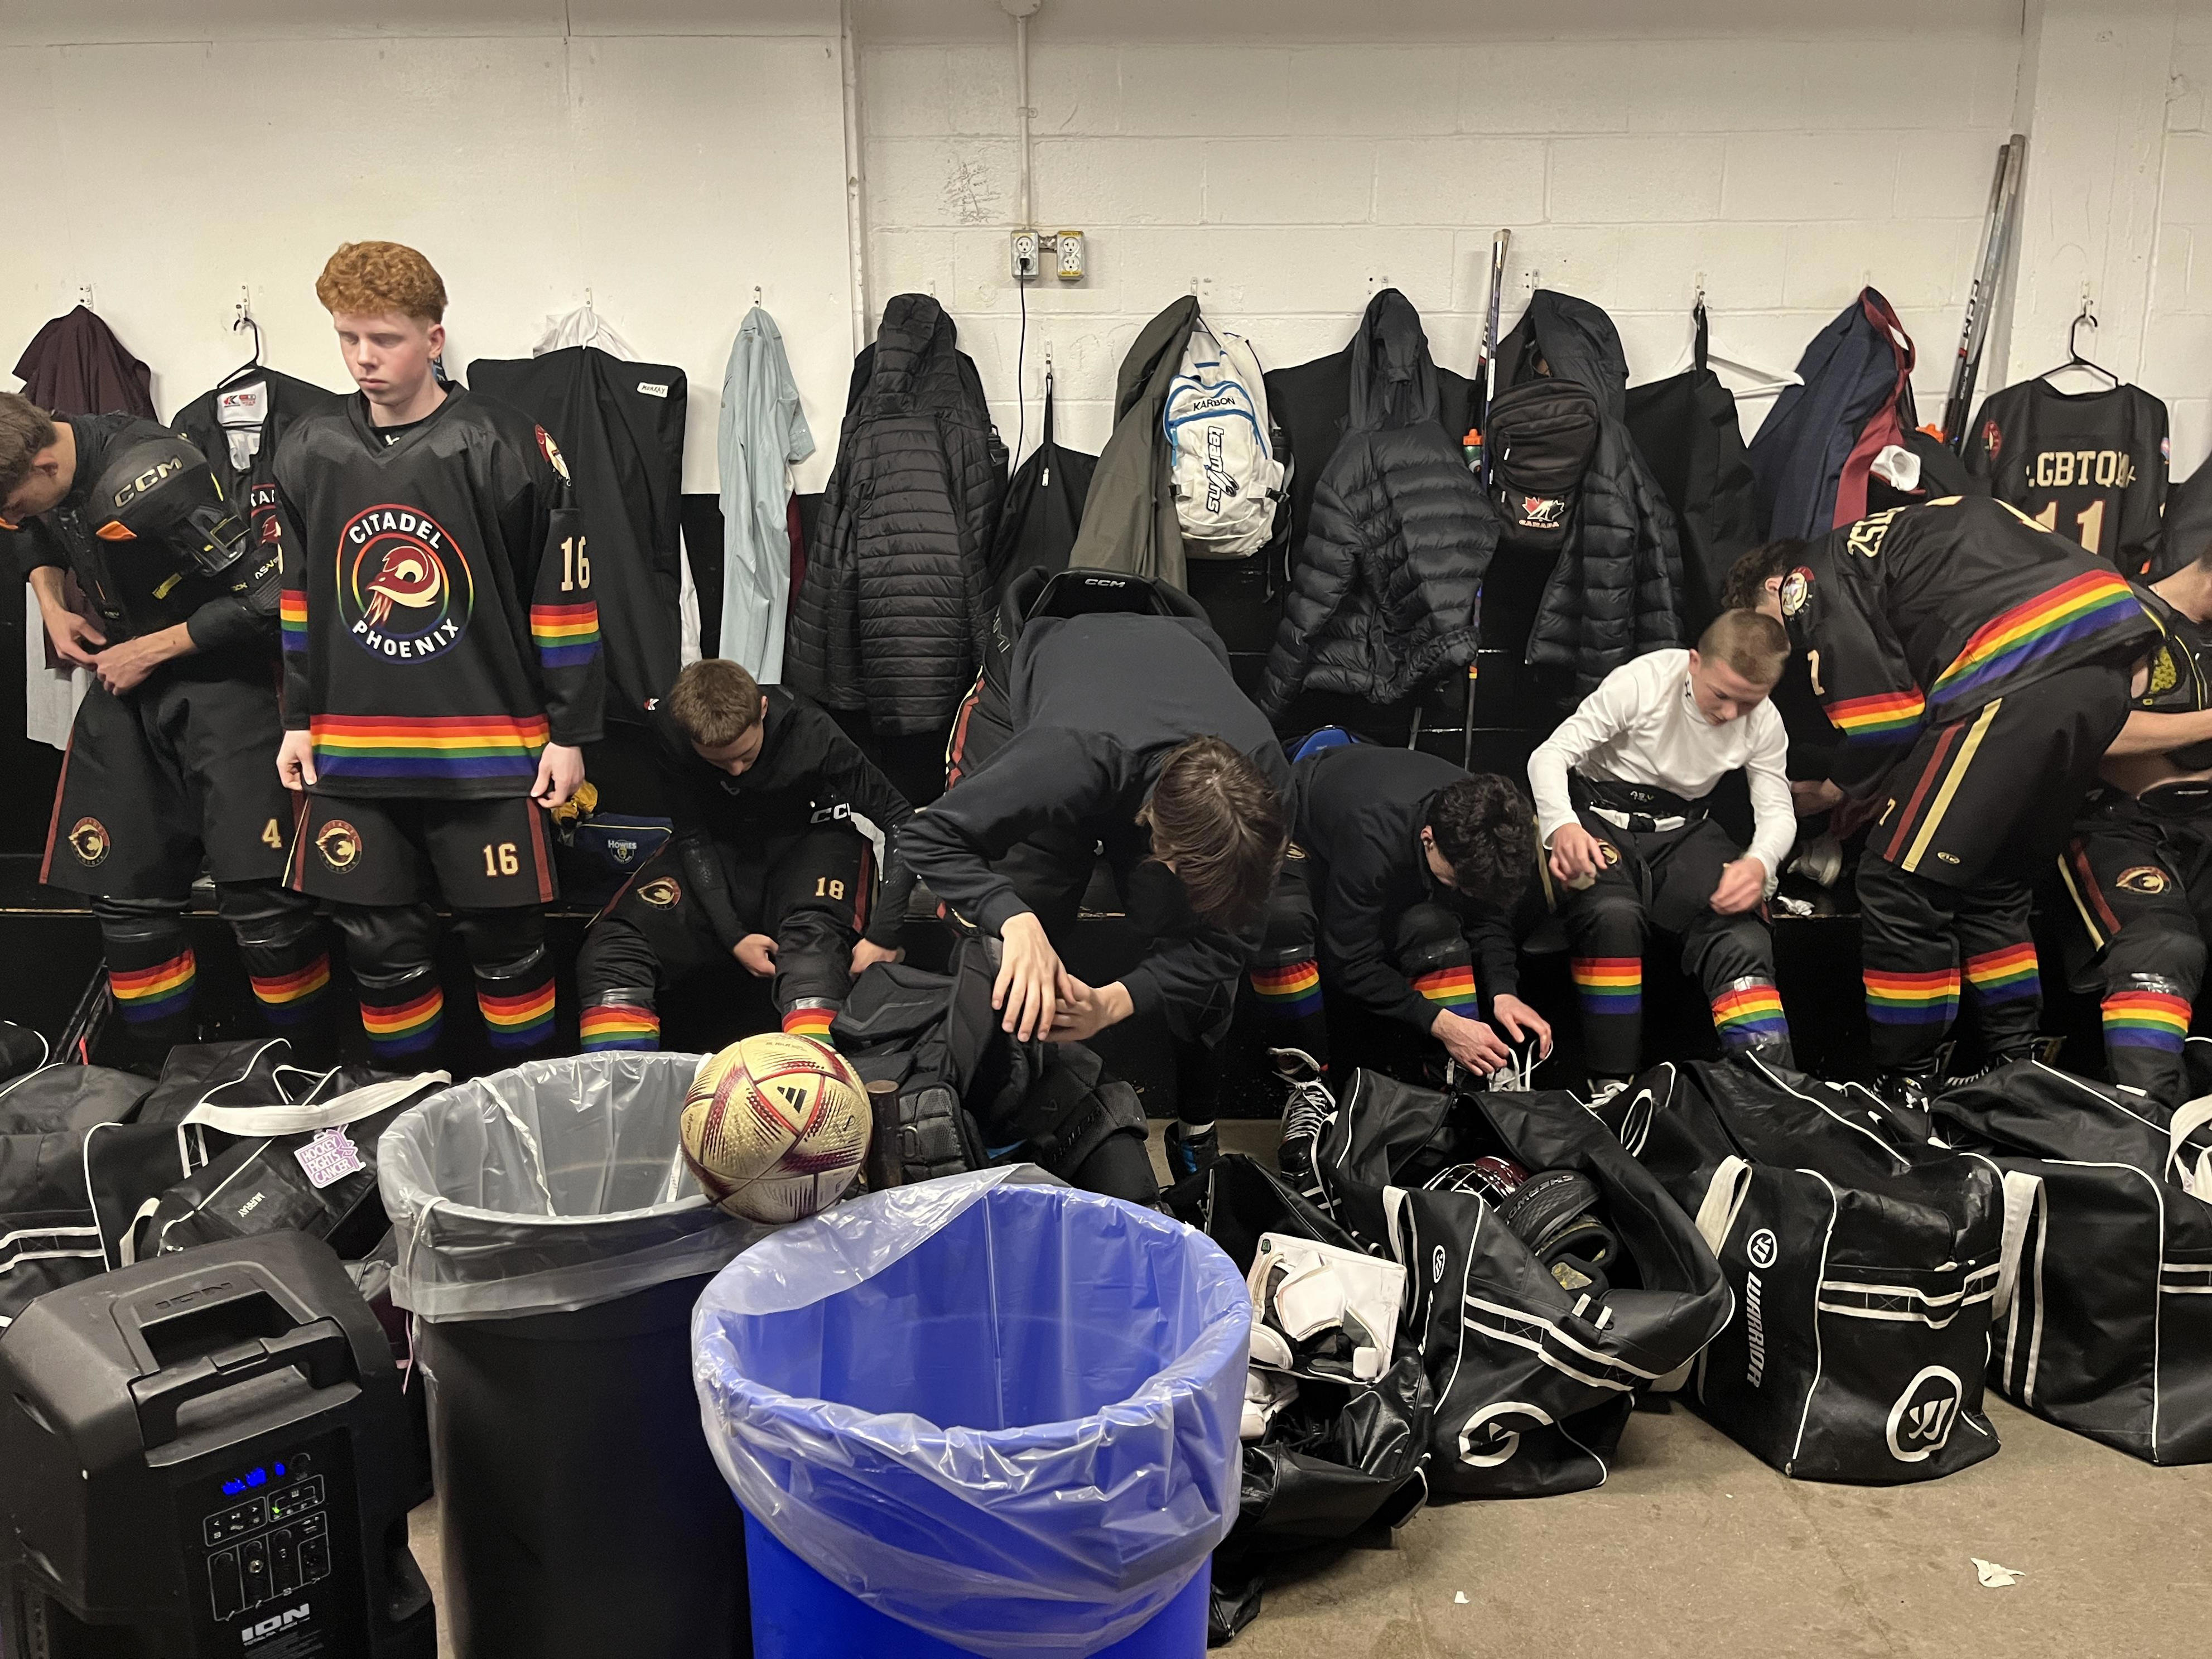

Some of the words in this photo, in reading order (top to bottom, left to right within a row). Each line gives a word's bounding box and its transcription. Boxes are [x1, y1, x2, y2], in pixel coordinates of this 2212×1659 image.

[1193, 397, 1236, 411] KARBON
[1207, 426, 1224, 473] team
[115, 457, 182, 507] CCM
[349, 512, 441, 549] CITADEL
[1519, 519, 1559, 528] CANADA
[561, 536, 590, 591] 16
[1085, 578, 1125, 588] CCM
[352, 619, 459, 658] PHOENIX
[810, 802, 851, 824] CC
[262, 818, 282, 848] 4
[608, 839, 637, 850] HOWIES
[484, 842, 519, 876] 16
[815, 876, 845, 900] 18
[301, 1137, 338, 1163] HOCKEY
[308, 1149, 341, 1173] FIGHTS
[314, 1159, 351, 1183] CANCER
[238, 1192, 266, 1218] MURRAY
[155, 1282, 233, 1309] ION
[1746, 1271, 1765, 1388] WARRIOR
[242, 1603, 310, 1643] ION
